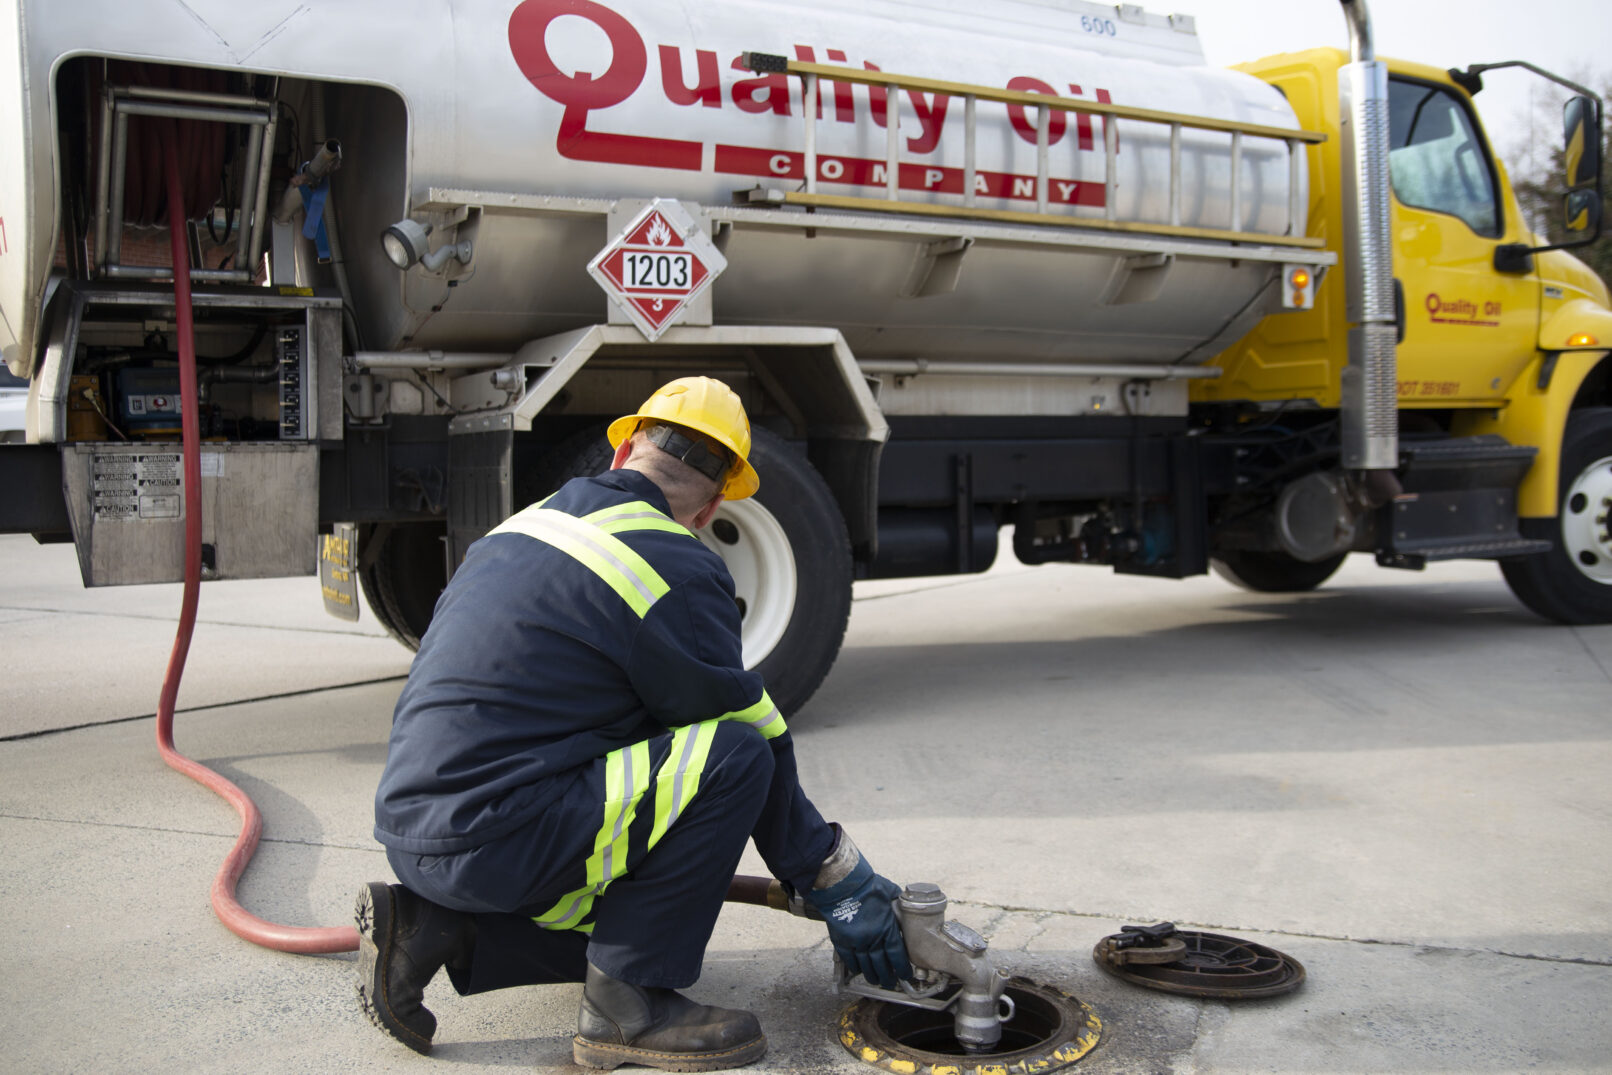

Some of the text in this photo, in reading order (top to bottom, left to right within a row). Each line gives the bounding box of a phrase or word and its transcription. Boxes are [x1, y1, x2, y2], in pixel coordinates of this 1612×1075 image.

[1081, 15, 1117, 37] 600
[508, 0, 1120, 171] Quality Oil
[769, 154, 1077, 200] COMPANY
[627, 254, 688, 287] 1203
[652, 297, 663, 312] 3
[1425, 292, 1501, 323] Quality Oil
[149, 479, 177, 487] CAUTION
[106, 504, 133, 512] CAUTION
